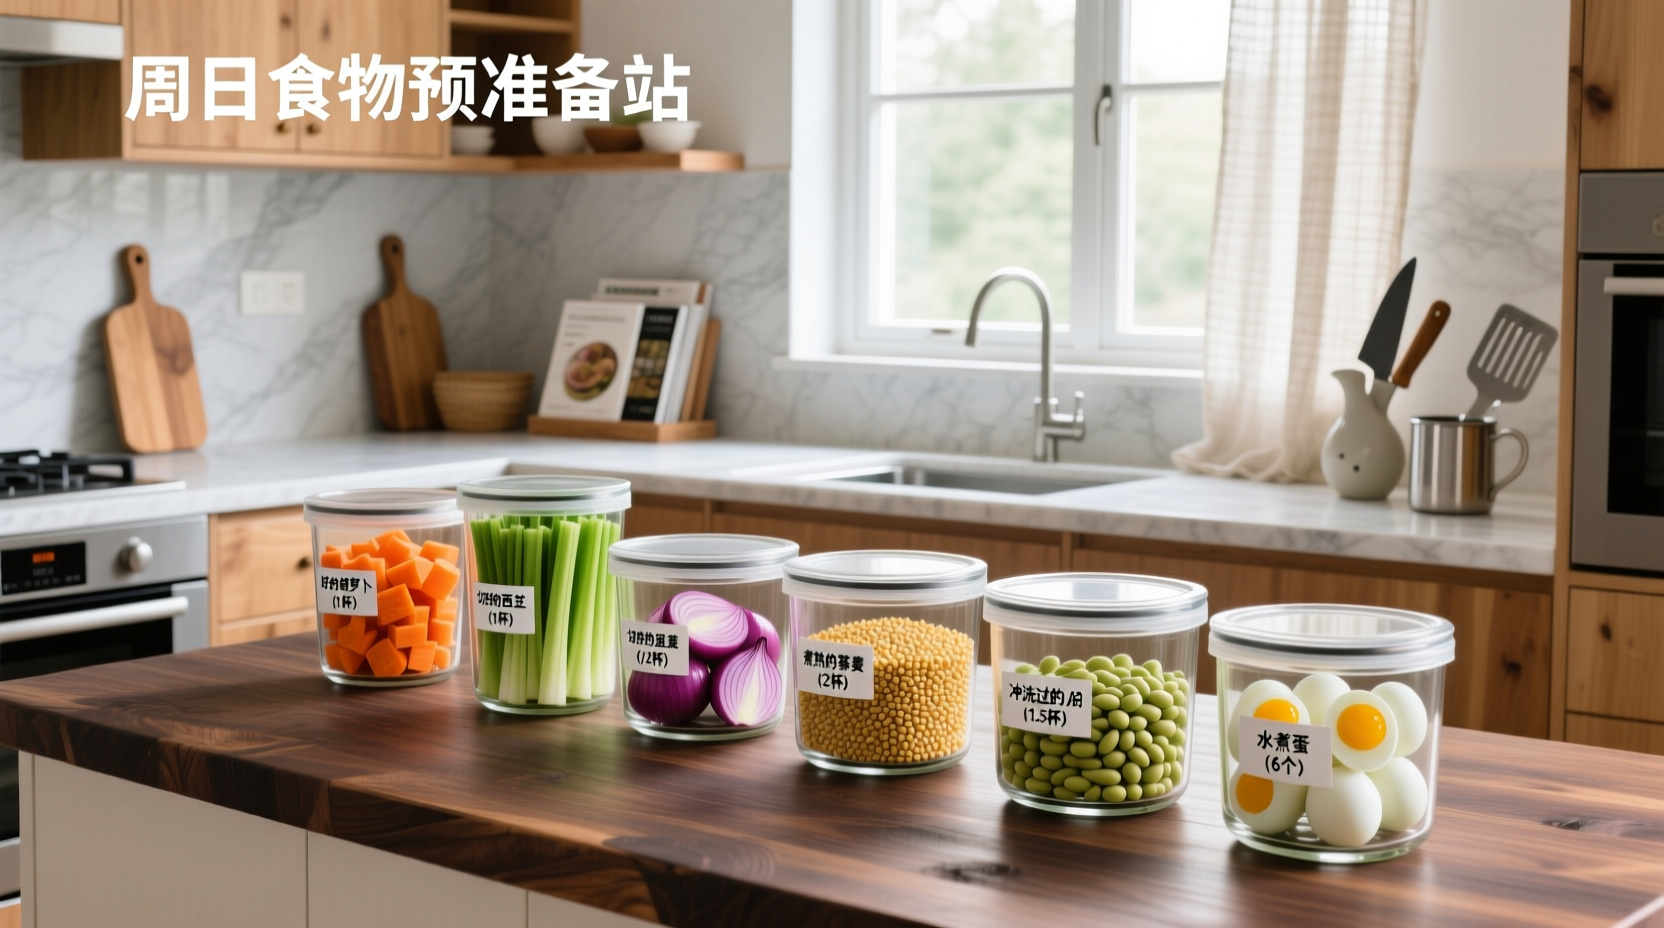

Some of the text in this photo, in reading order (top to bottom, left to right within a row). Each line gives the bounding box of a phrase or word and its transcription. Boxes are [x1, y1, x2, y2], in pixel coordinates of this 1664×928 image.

[1256, 729, 1311, 754] 水煮蛋
[1264, 754, 1304, 777] (6个)
